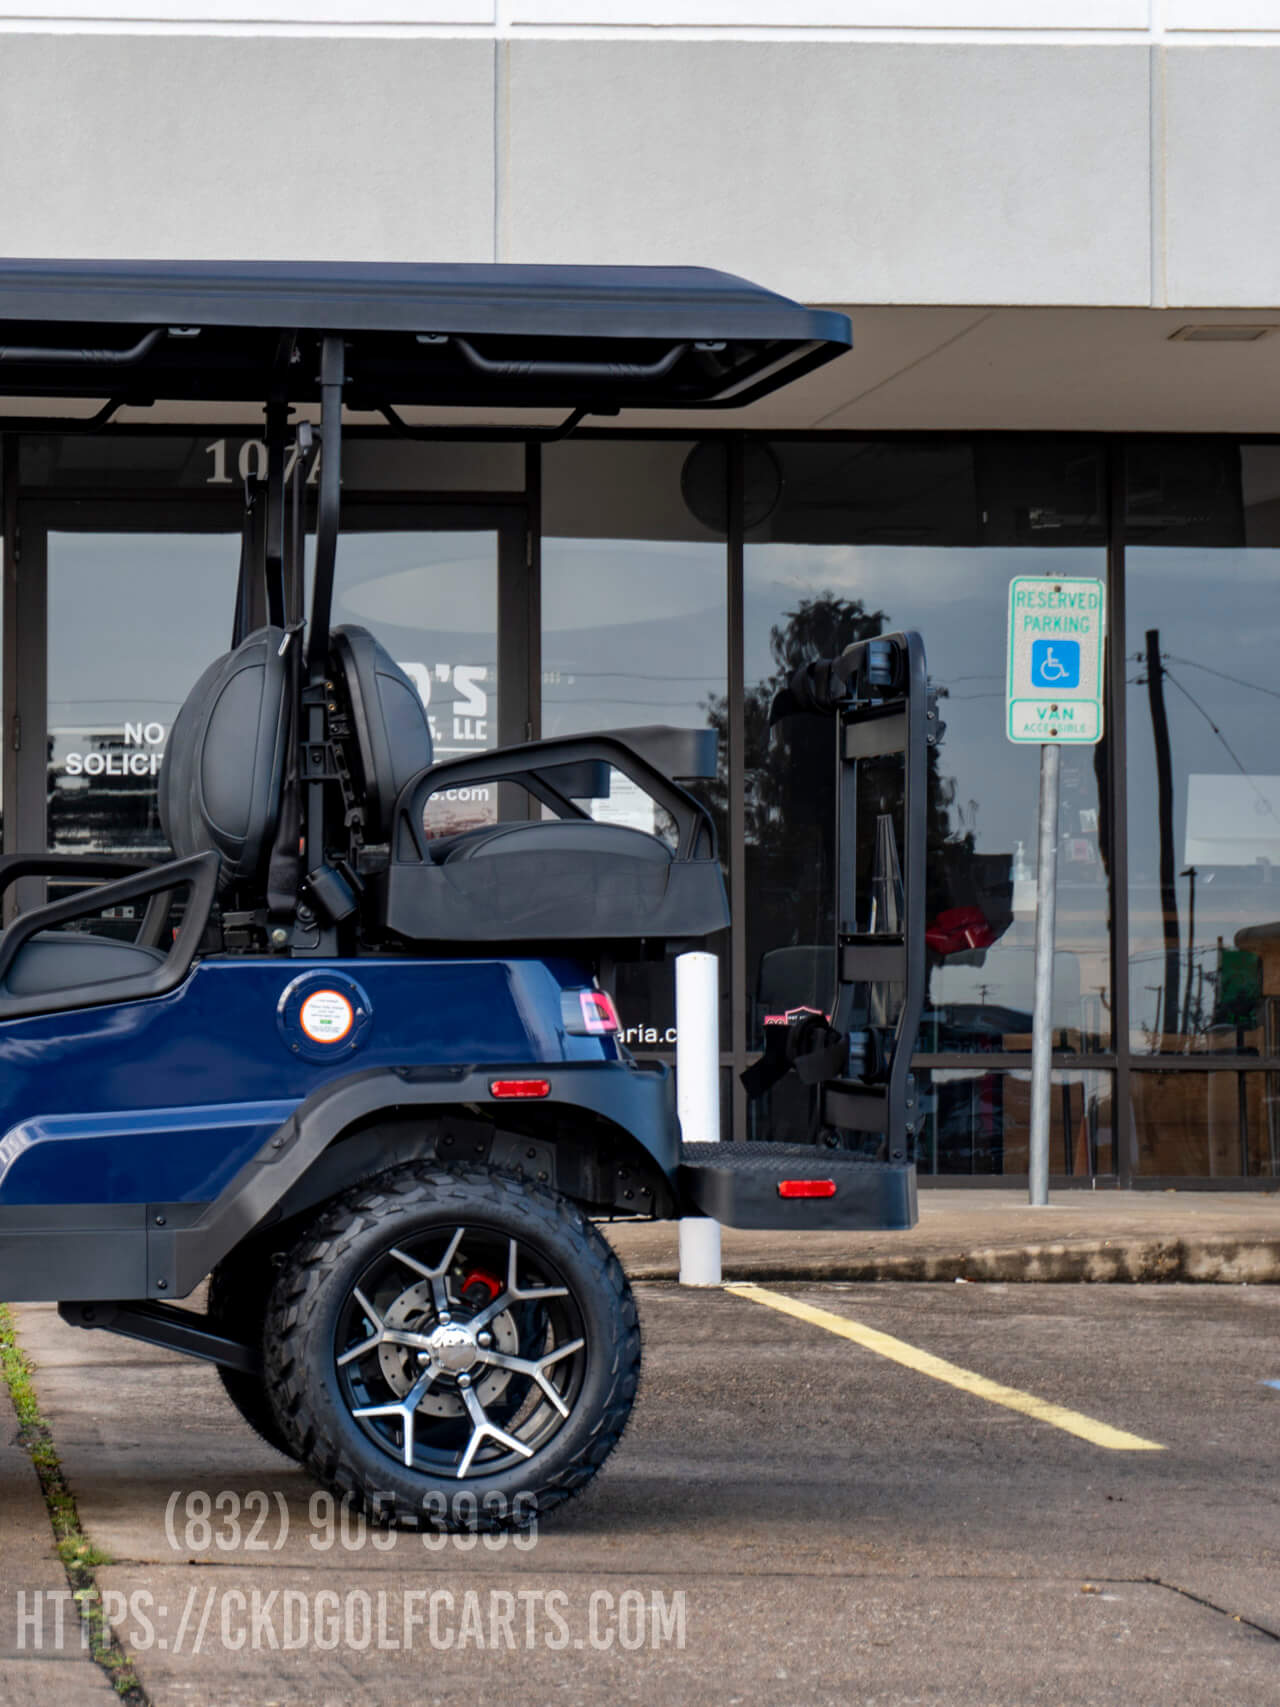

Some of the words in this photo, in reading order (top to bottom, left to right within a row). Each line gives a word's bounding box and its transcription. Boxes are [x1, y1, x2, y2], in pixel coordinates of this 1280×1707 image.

[206, 439, 343, 485] 107
[1016, 591, 1098, 609] RESERVED
[1023, 615, 1090, 634] PARKING
[1036, 706, 1075, 721] VAN
[124, 722, 165, 744] NO
[452, 717, 488, 740] LLC
